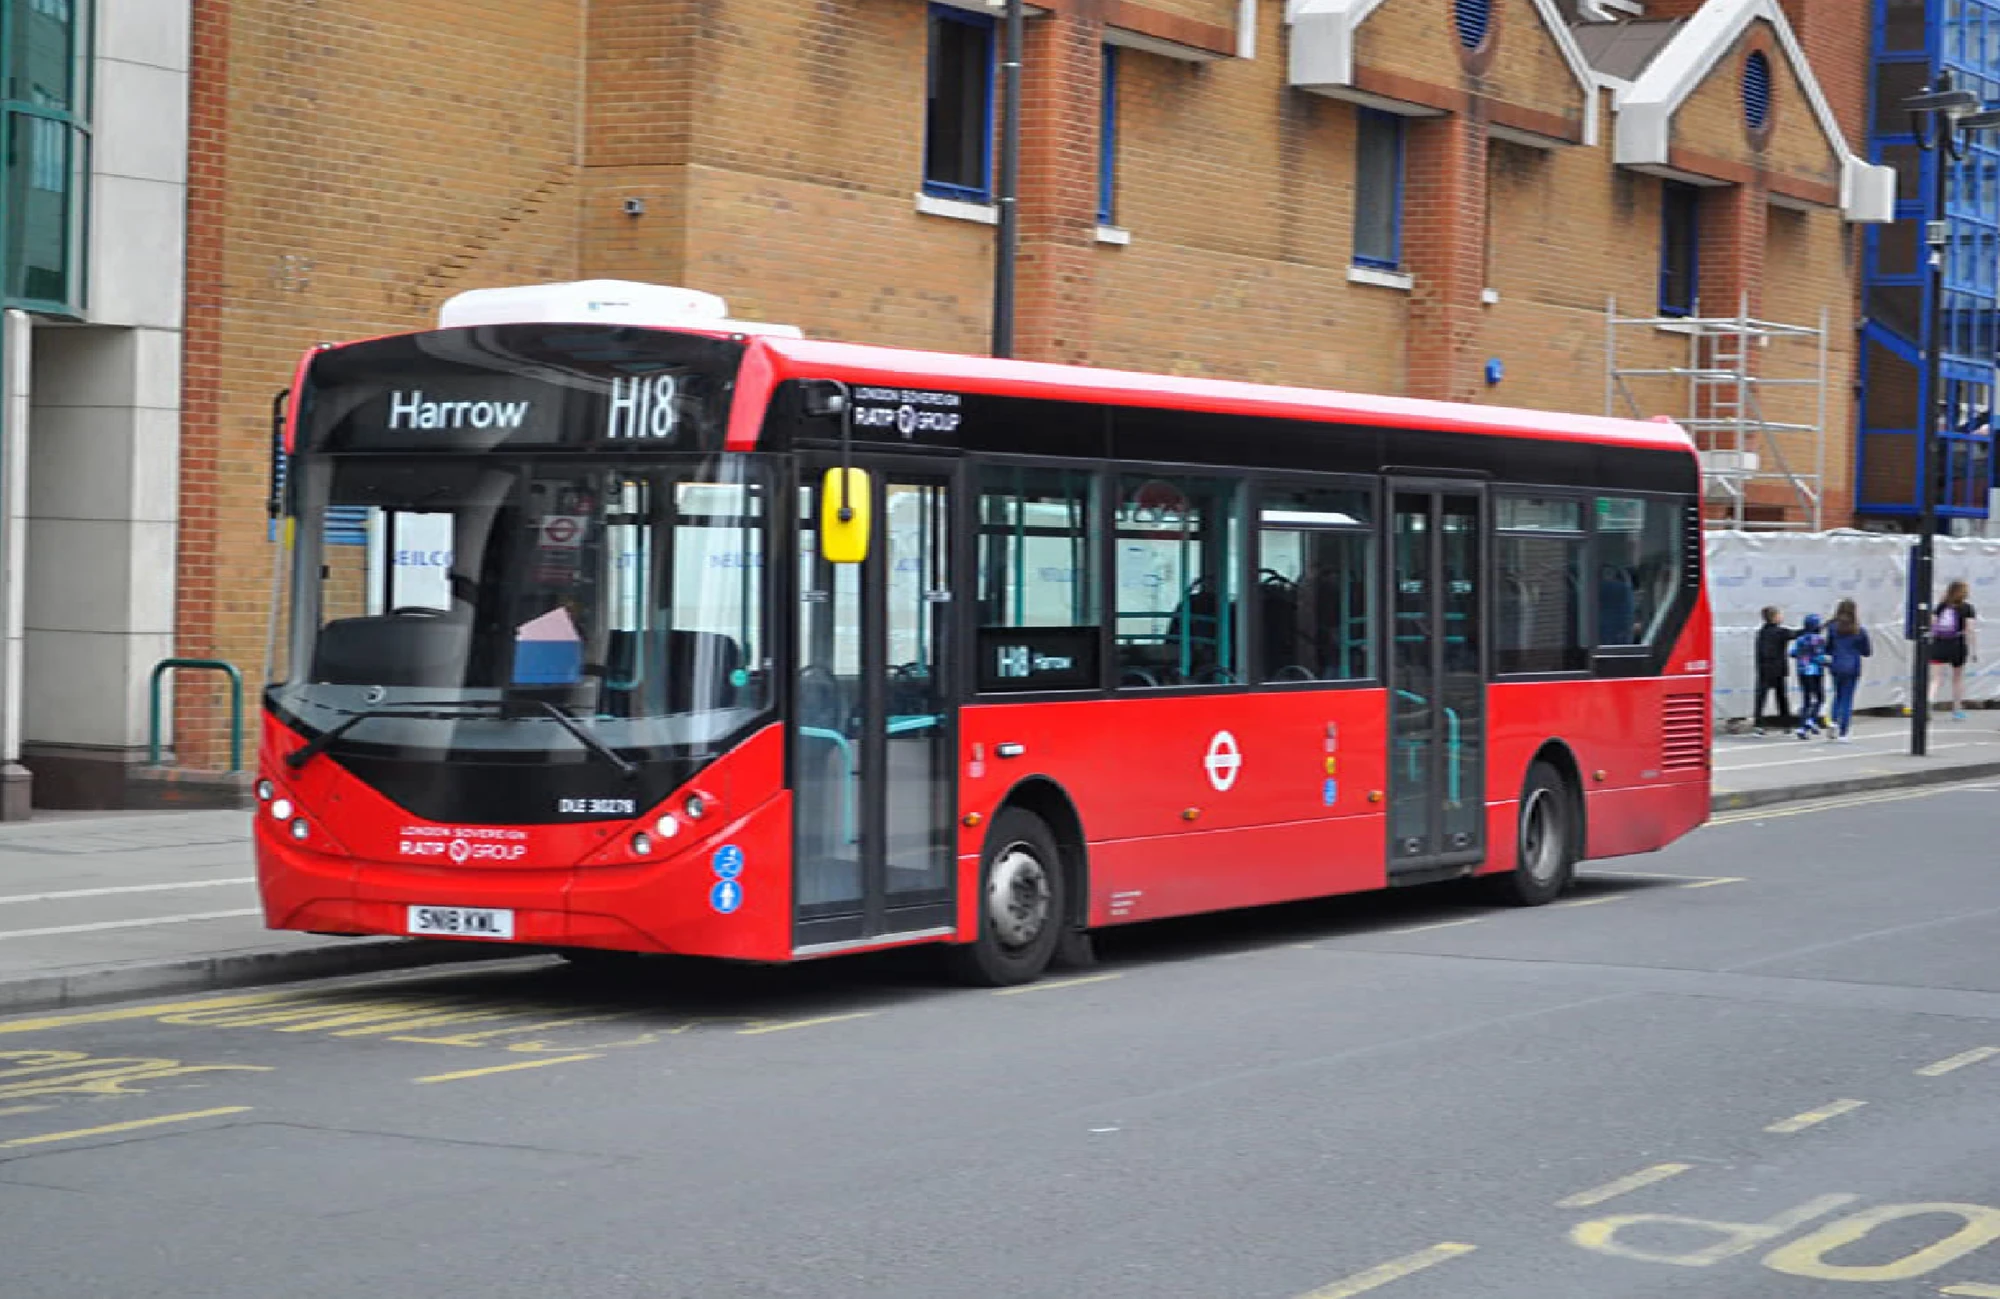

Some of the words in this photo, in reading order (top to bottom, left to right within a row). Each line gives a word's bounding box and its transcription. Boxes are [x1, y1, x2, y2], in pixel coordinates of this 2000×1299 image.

[388, 390, 530, 429] Harrow
[607, 375, 676, 439] H18
[855, 407, 894, 426] RATP
[917, 411, 961, 431] GROUP
[558, 799, 585, 813] DLE
[399, 826, 451, 838] LONDON
[399, 841, 446, 856] RATP
[473, 845, 527, 860] GROUP
